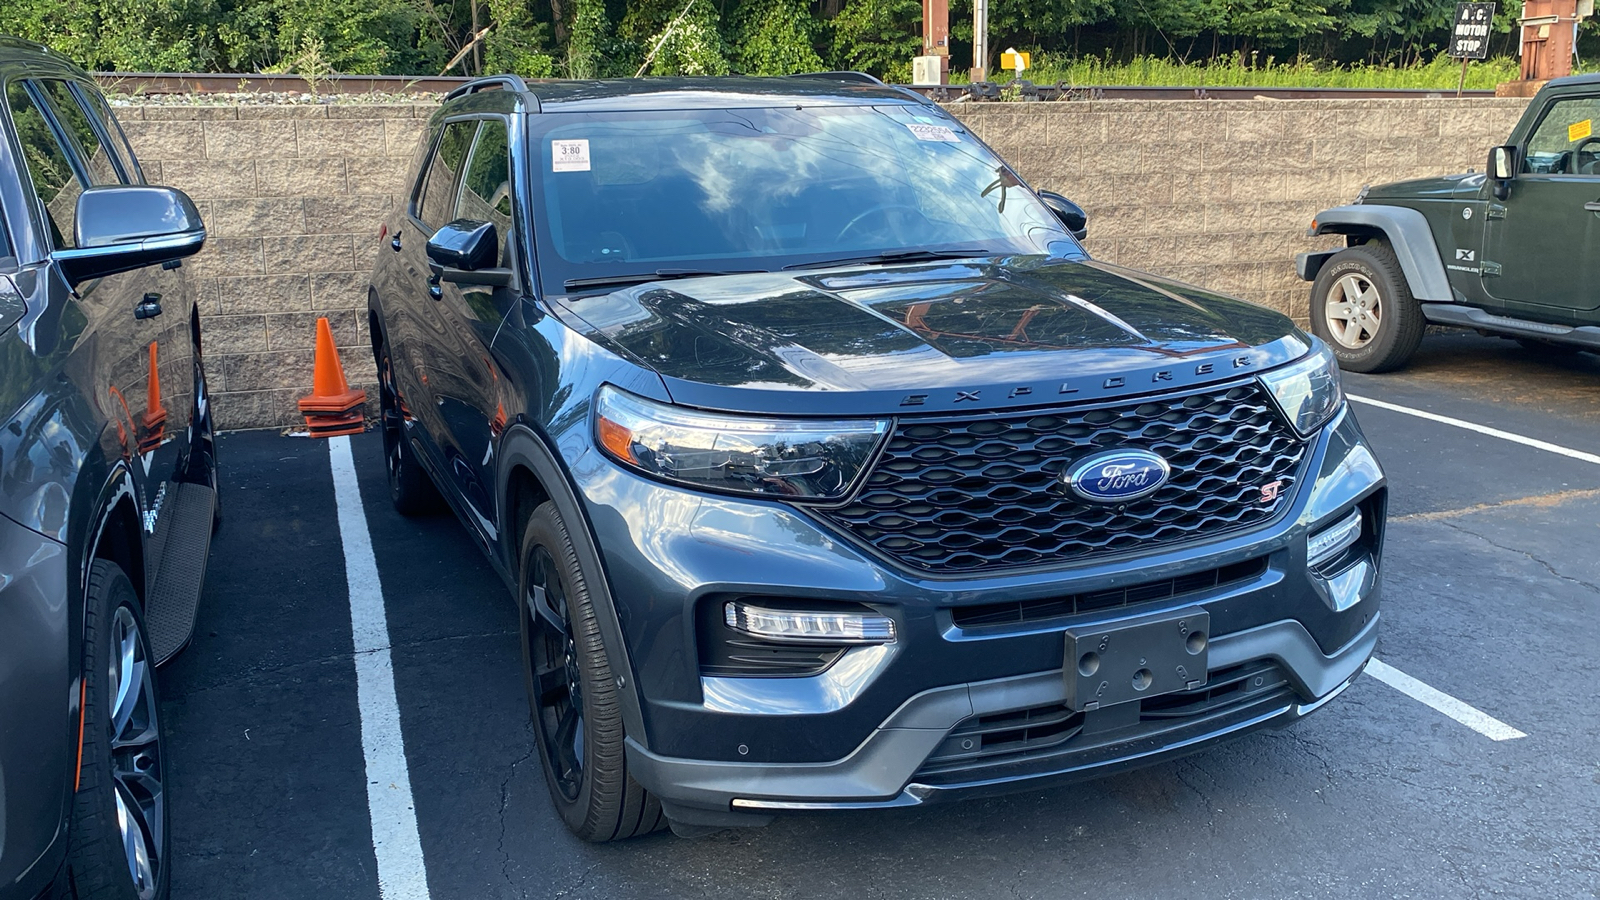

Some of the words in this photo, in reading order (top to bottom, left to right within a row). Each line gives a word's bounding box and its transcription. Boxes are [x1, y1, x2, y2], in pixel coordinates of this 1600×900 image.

[1455, 24, 1488, 37] MOTOR
[1456, 40, 1481, 52] STOP
[561, 146, 580, 155] 3:80
[899, 356, 1252, 407] EXPLORER
[1097, 462, 1151, 492] Ford
[1260, 480, 1283, 503] ST
